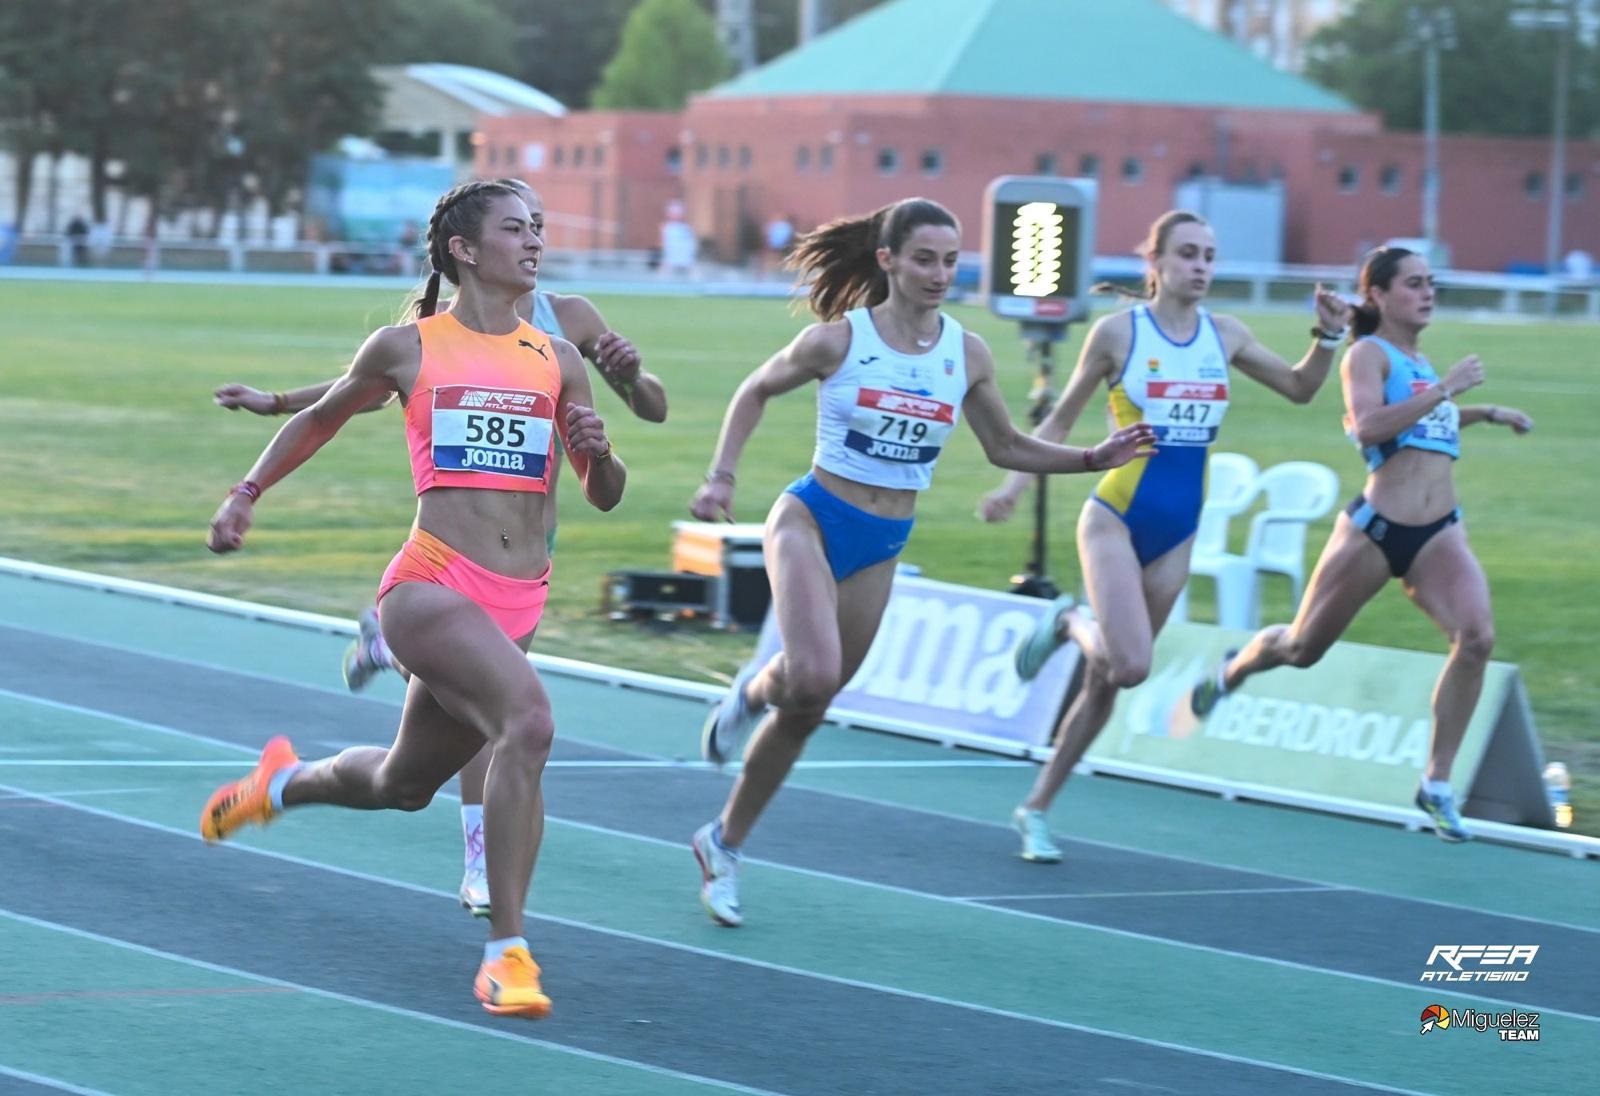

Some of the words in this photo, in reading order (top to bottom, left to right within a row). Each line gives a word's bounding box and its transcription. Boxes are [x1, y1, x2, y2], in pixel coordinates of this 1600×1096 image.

[488, 393, 537, 406] RFEA
[1168, 403, 1211, 424] 447
[465, 414, 526, 448] 585
[877, 415, 928, 444] 719
[461, 447, 526, 471] Joma
[843, 594, 1036, 719] ma
[1204, 693, 1432, 769] IBERDROLA
